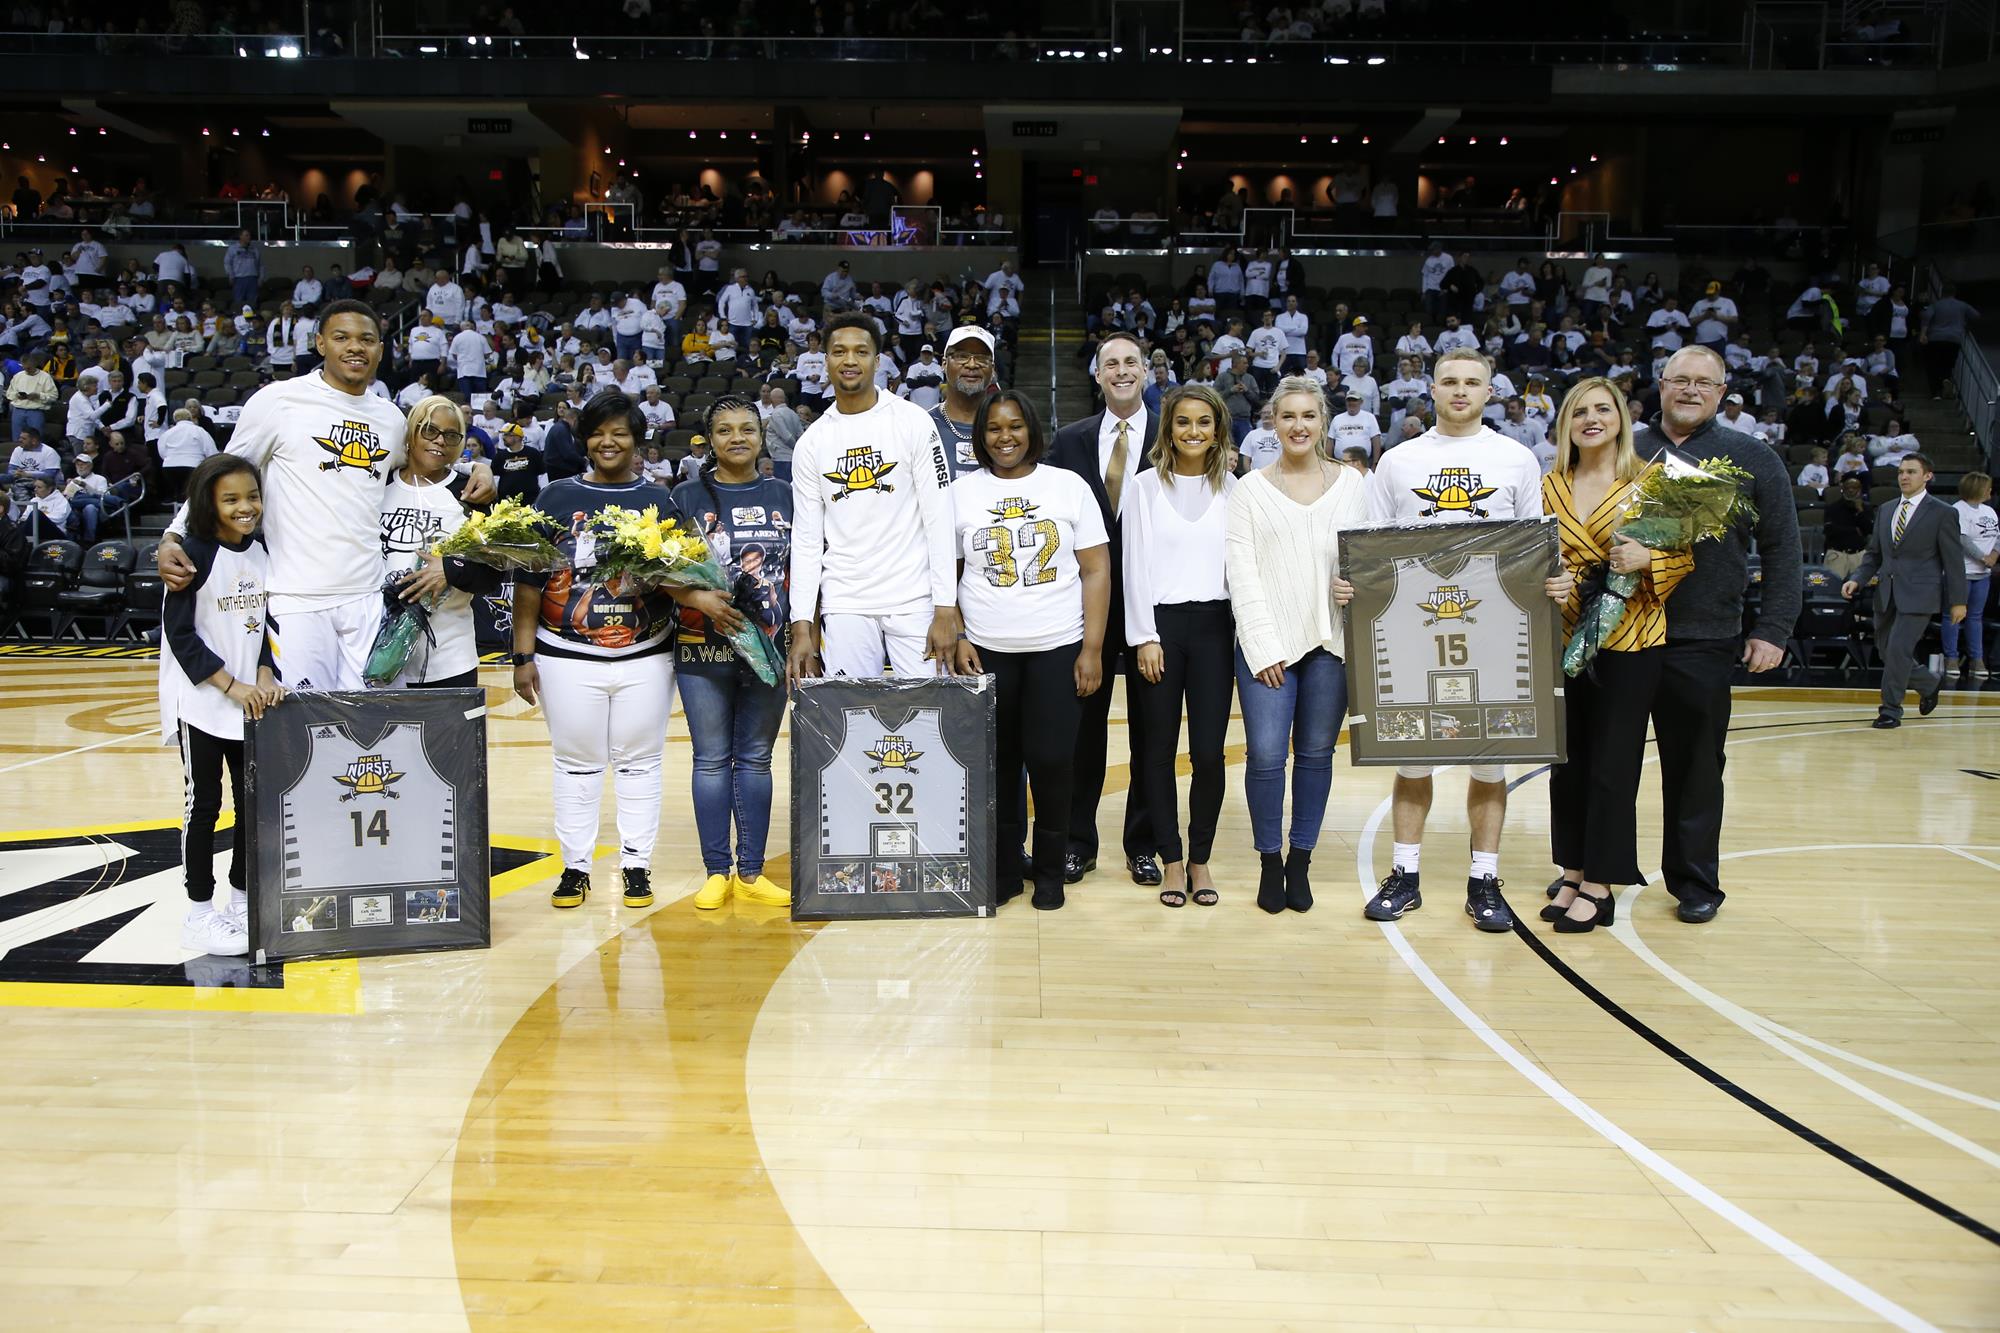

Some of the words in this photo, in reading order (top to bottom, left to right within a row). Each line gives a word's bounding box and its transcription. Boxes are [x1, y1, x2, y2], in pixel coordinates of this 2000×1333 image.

[344, 421, 369, 431] NKU
[330, 426, 379, 450] NORSE
[847, 447, 870, 456] NKU
[837, 453, 882, 472] NORSE
[932, 445, 949, 489] NORSE
[1427, 475, 1480, 491] NORSE
[397, 508, 429, 518] NKU
[754, 530, 779, 538] ARENA
[972, 518, 1061, 587] 32
[1428, 591, 1469, 604] NORSE
[603, 615, 624, 627] 32
[697, 645, 735, 662] Walt
[1434, 633, 1468, 667] 15
[875, 741, 911, 752] NORSE
[348, 761, 392, 775] NORSE
[874, 782, 914, 815] 32
[350, 809, 391, 848] 14
